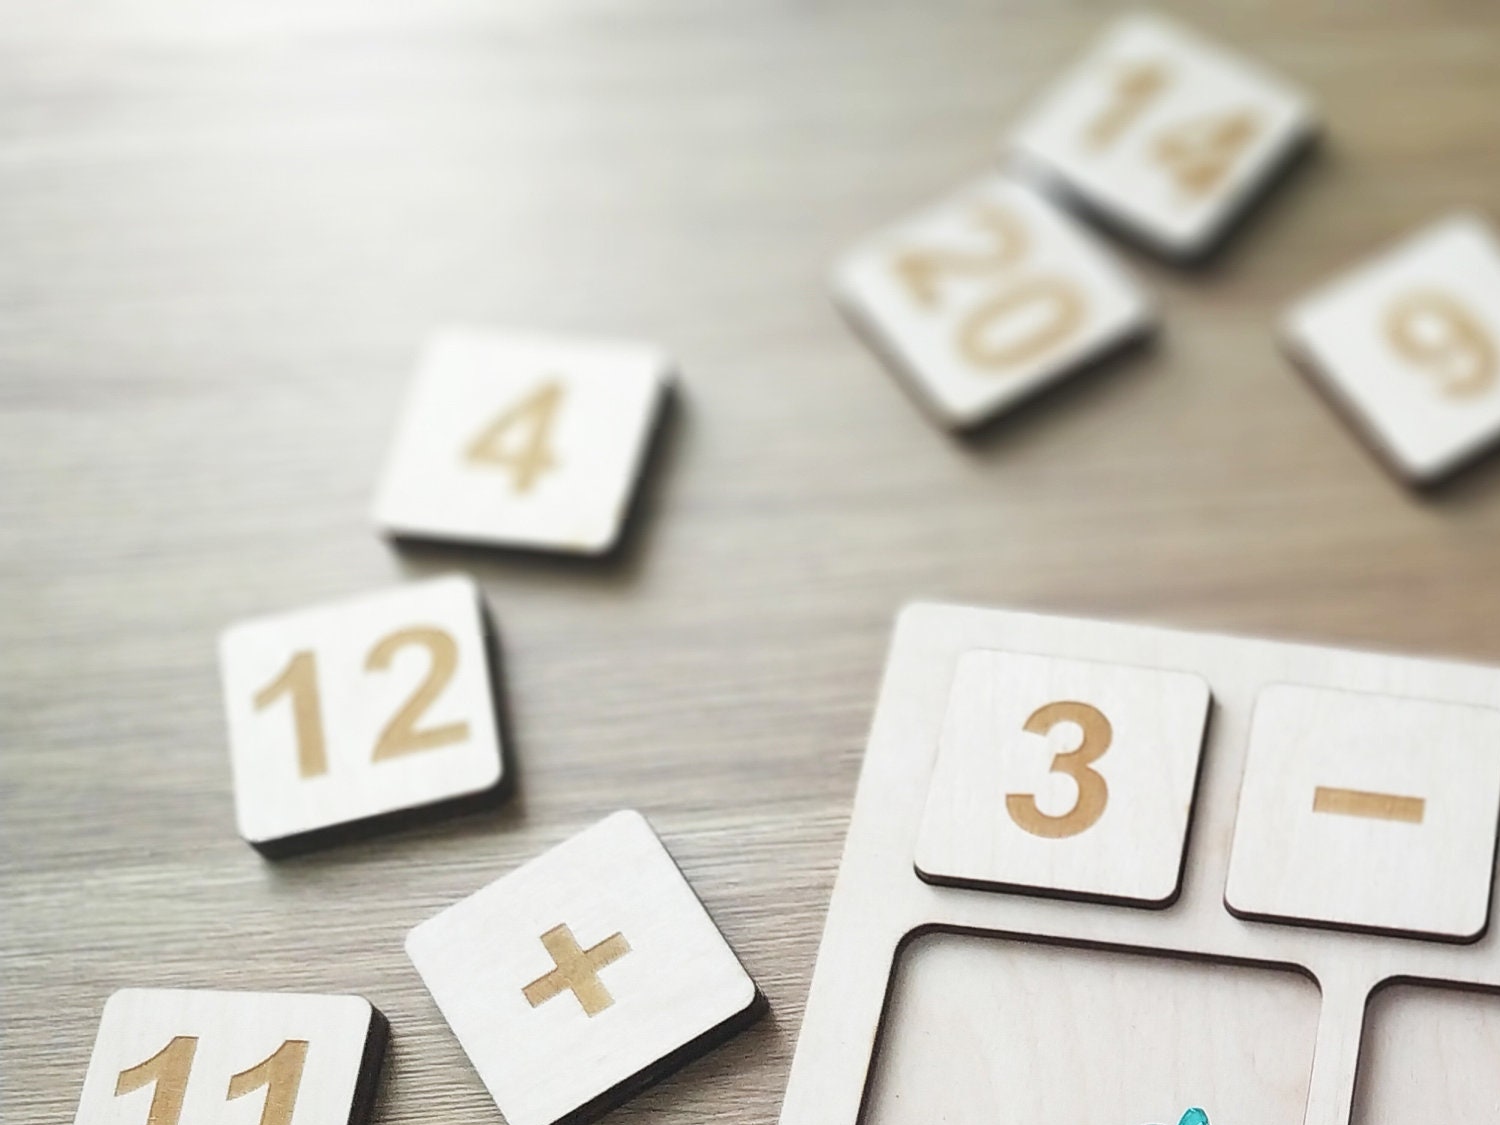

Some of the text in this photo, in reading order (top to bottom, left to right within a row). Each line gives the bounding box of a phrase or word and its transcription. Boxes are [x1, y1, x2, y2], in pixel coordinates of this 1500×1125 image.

[1084, 62, 1266, 202] 14
[893, 206, 1091, 374] 20
[463, 378, 567, 497] 4
[254, 626, 470, 779] 12
[1006, 701, 1113, 838] 3
